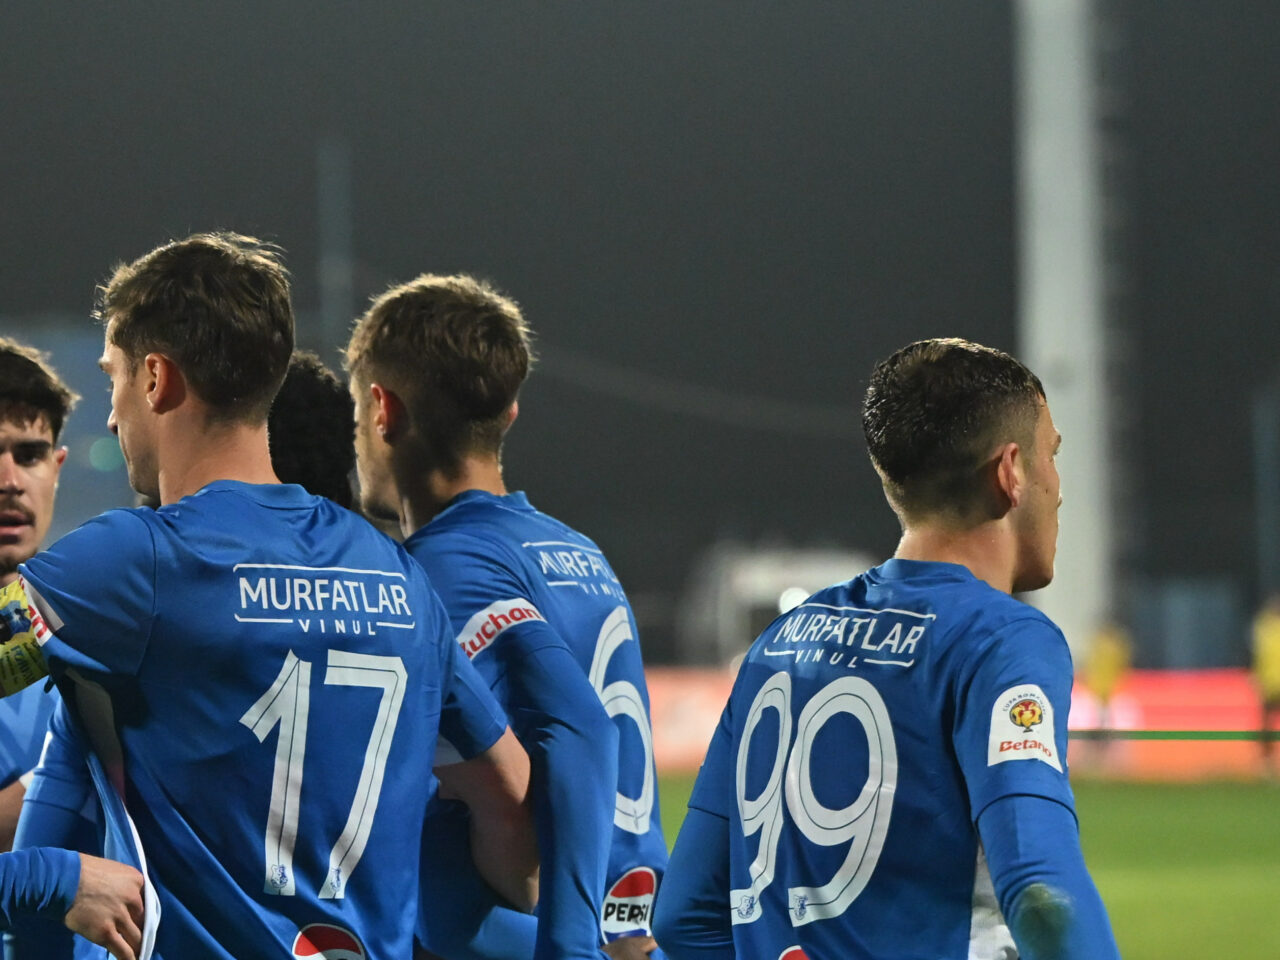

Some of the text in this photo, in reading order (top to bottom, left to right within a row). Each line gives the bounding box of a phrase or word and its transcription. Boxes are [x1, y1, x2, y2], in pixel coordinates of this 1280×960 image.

[239, 577, 412, 616] MURFATLAR
[298, 619, 376, 636] VINUL
[773, 613, 925, 655] MURFATLAR
[795, 649, 859, 668] VINUL
[588, 605, 655, 835] 6
[999, 739, 1052, 757] Betano
[238, 648, 408, 900] 17
[730, 671, 898, 928] 99
